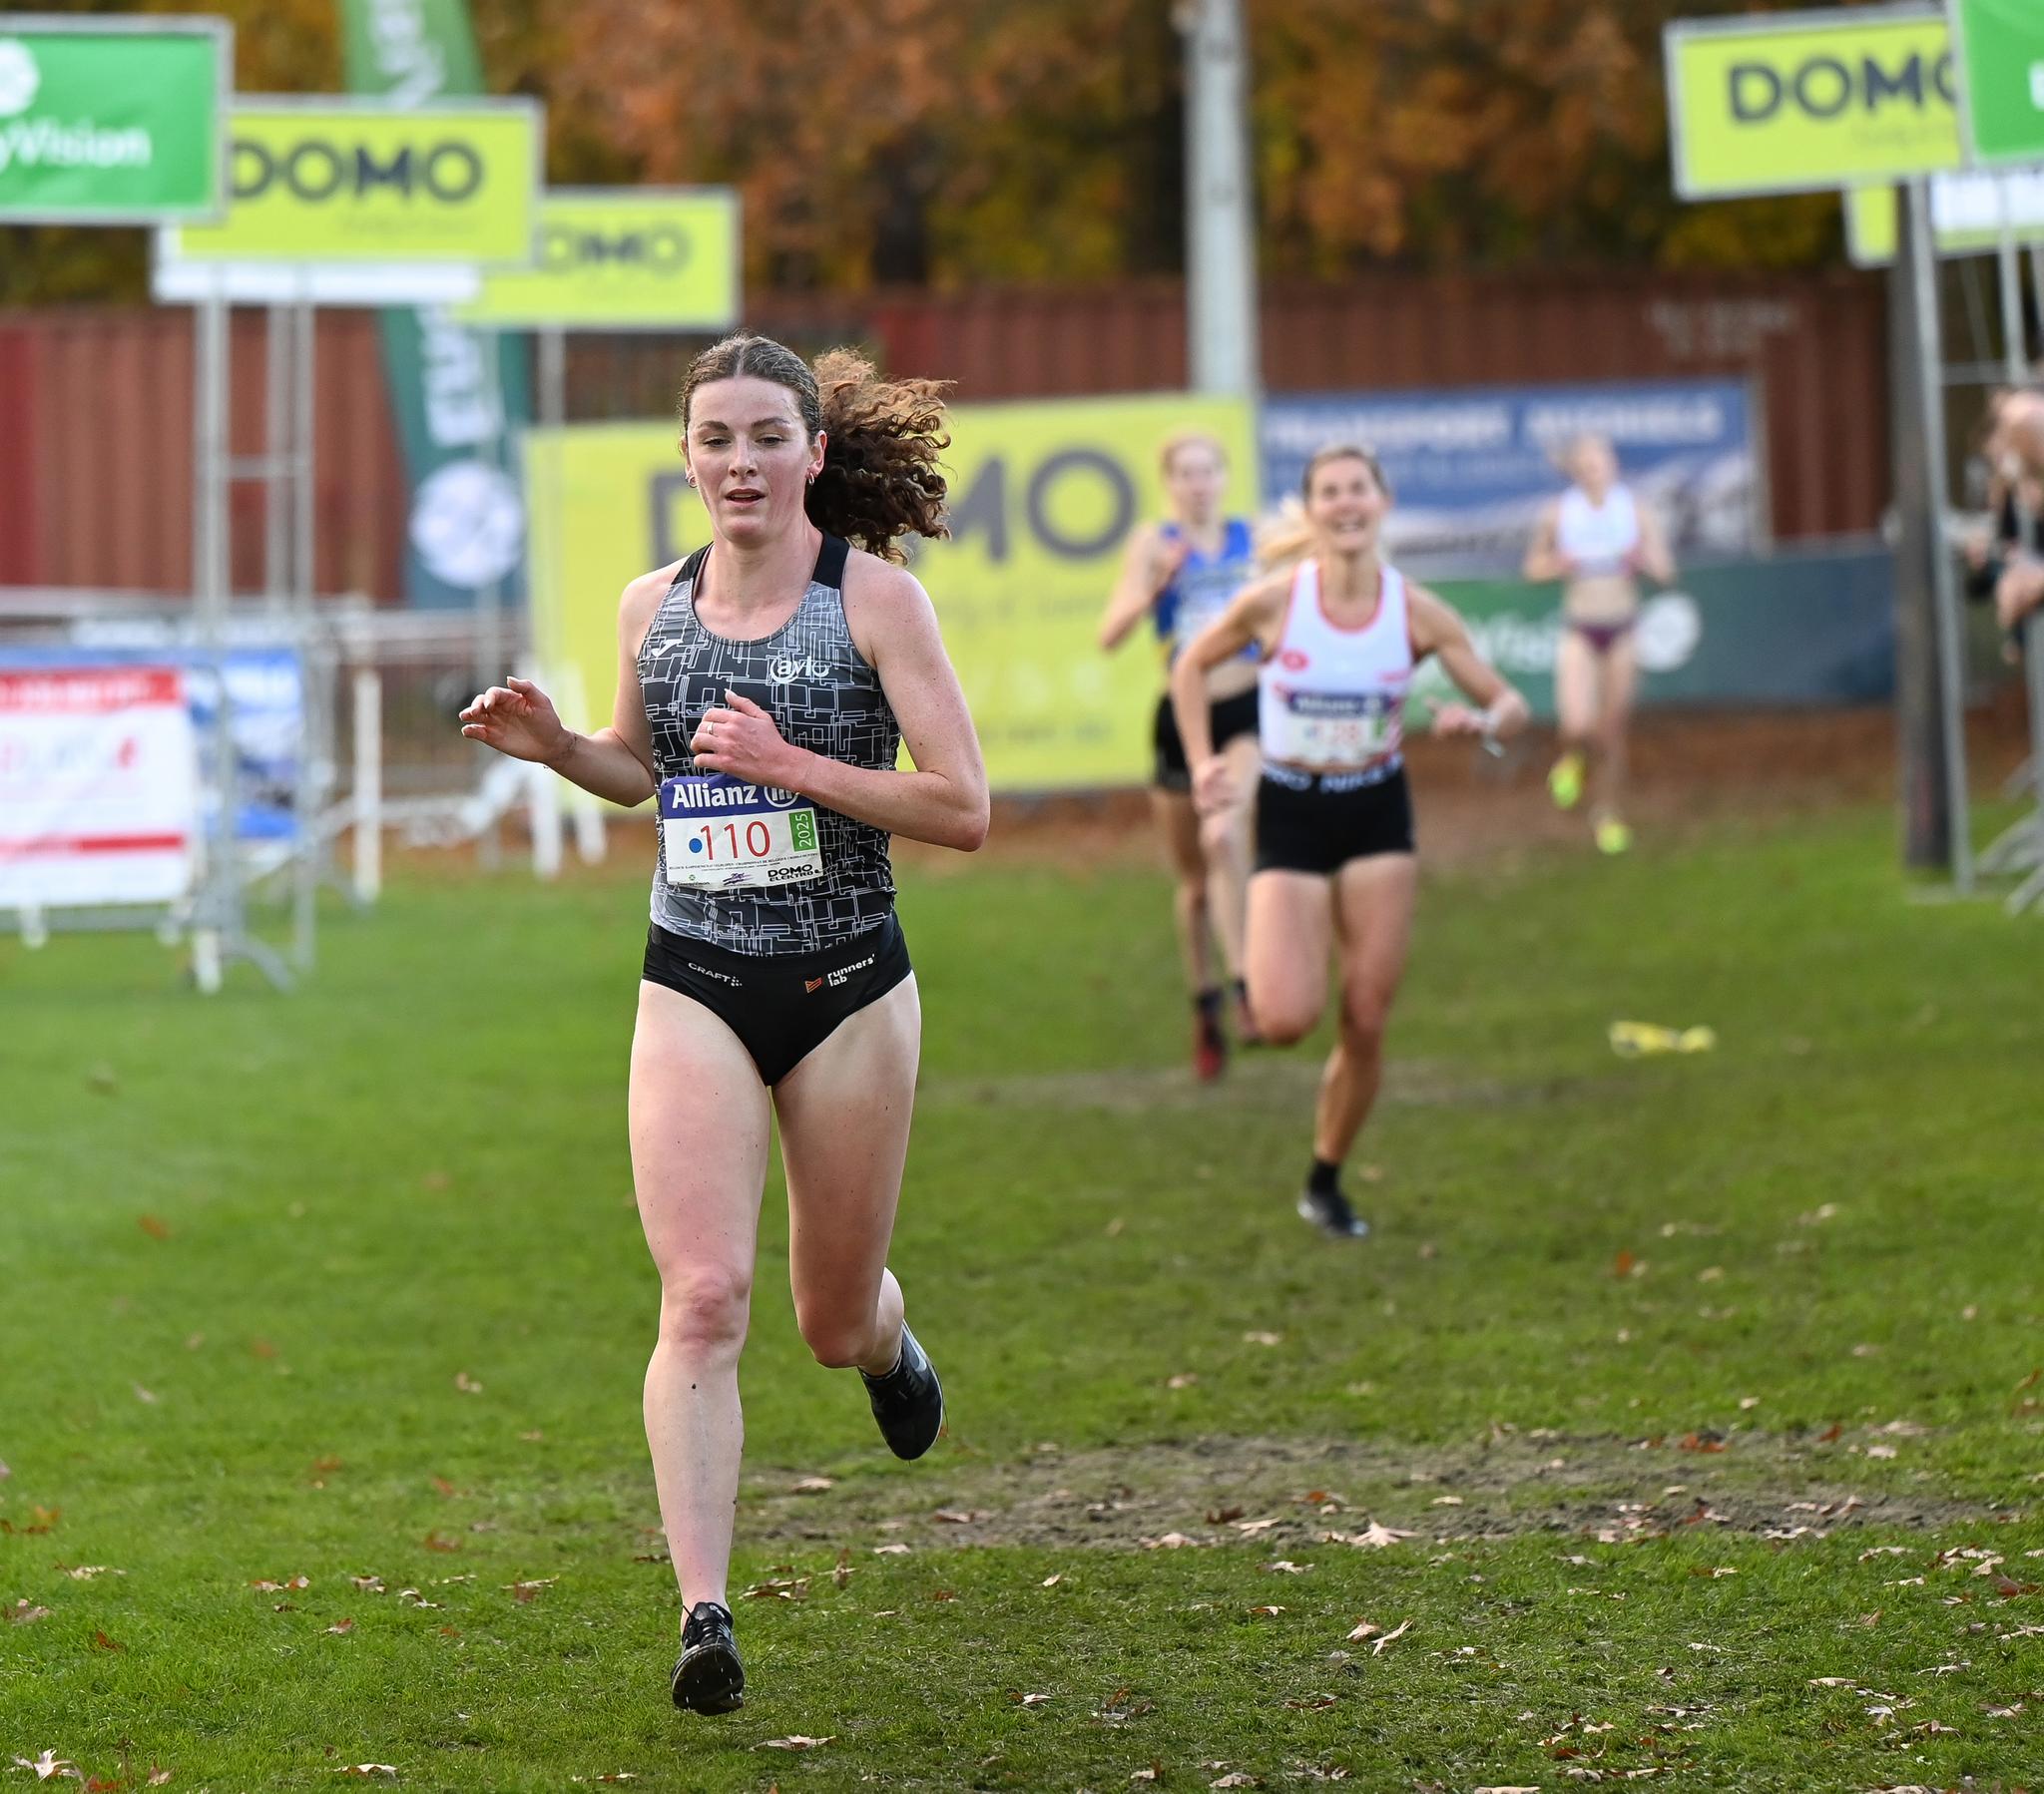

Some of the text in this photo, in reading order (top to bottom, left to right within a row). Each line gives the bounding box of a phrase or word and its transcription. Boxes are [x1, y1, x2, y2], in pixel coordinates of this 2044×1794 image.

[672, 783, 759, 809] Allianz
[701, 820, 771, 861] 110
[795, 813, 812, 847] 2025
[767, 864, 813, 878] DOMO
[688, 962, 731, 983] CRAFT
[827, 954, 875, 980] runners'
[828, 975, 848, 987] lab
